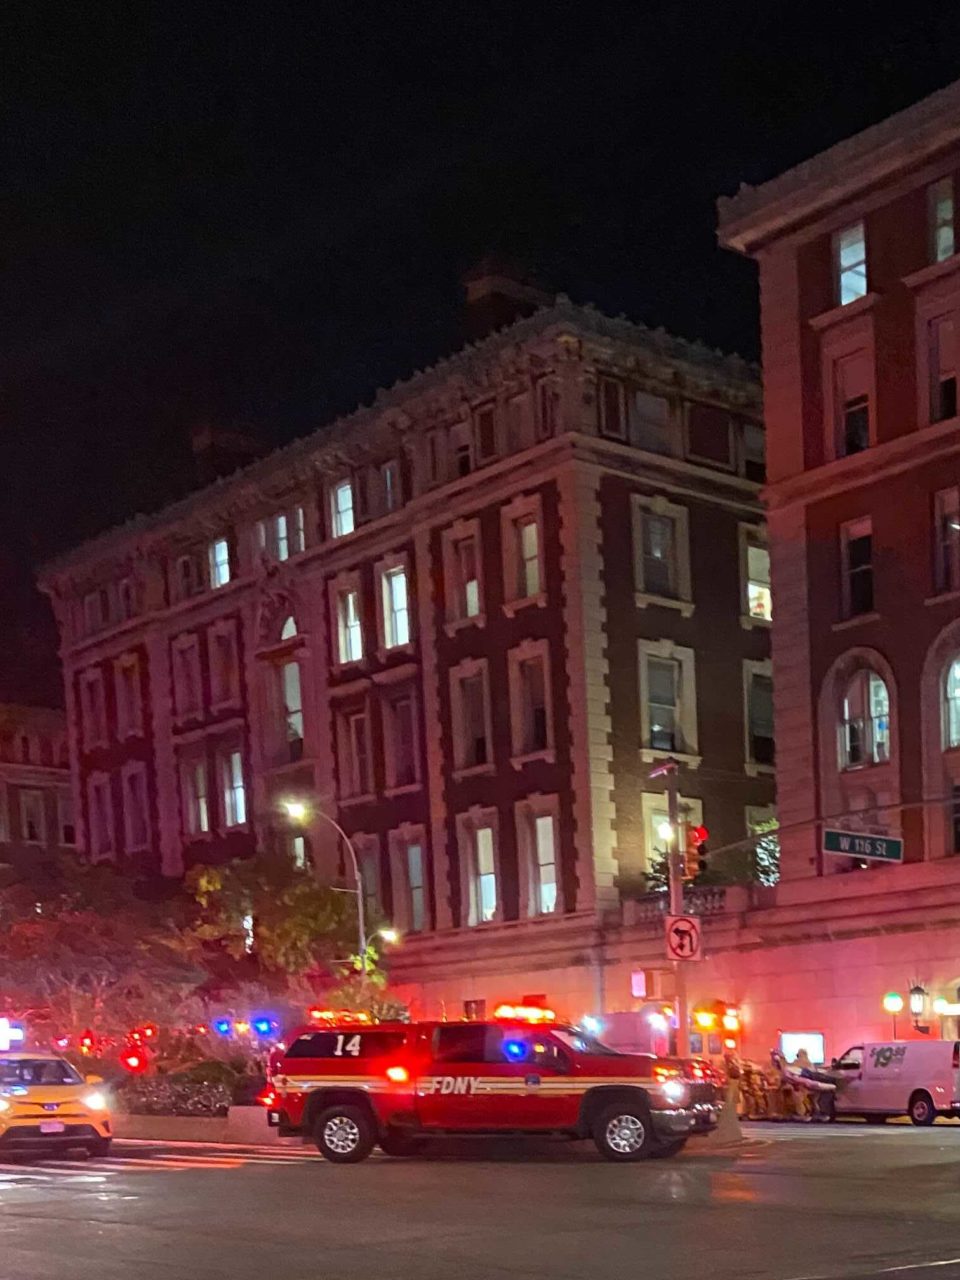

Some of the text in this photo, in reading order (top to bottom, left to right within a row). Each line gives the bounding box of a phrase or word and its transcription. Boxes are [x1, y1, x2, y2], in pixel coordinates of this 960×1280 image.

[840, 836, 887, 855] W 116 St
[333, 1034, 362, 1056] 14
[430, 1076, 481, 1095] FDNY
